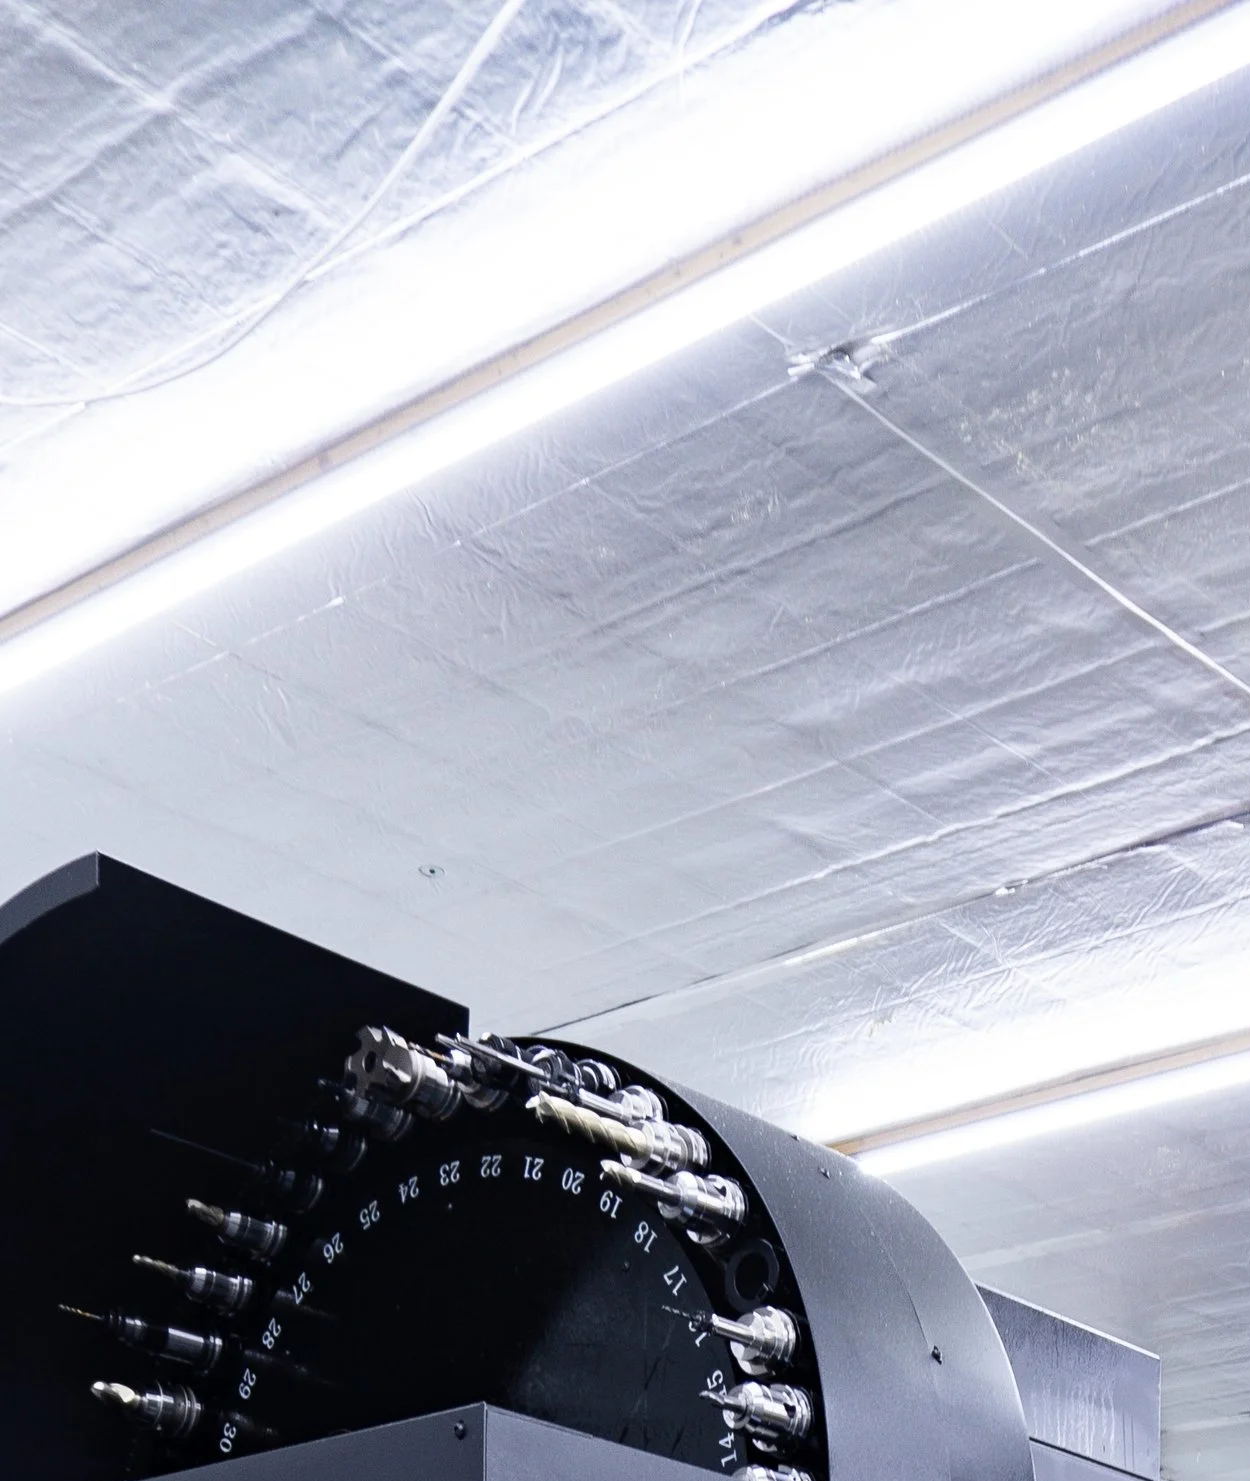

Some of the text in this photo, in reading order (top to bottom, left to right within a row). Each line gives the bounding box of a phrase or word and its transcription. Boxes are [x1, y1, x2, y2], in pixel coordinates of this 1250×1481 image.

[440, 1161, 459, 1185] 23
[481, 1155, 501, 1177] 22
[524, 1157, 544, 1180] 21
[400, 1177, 418, 1203] 24
[562, 1168, 584, 1194] 20
[360, 1201, 379, 1229] 25
[600, 1191, 622, 1218] 19
[324, 1233, 343, 1263] 26
[635, 1221, 657, 1253] 18
[289, 1273, 310, 1304] 27
[664, 1266, 687, 1296] 17
[263, 1318, 281, 1349] 28
[239, 1369, 256, 1399] 29
[220, 1423, 236, 1452] 30
[718, 1431, 738, 1468] 14
